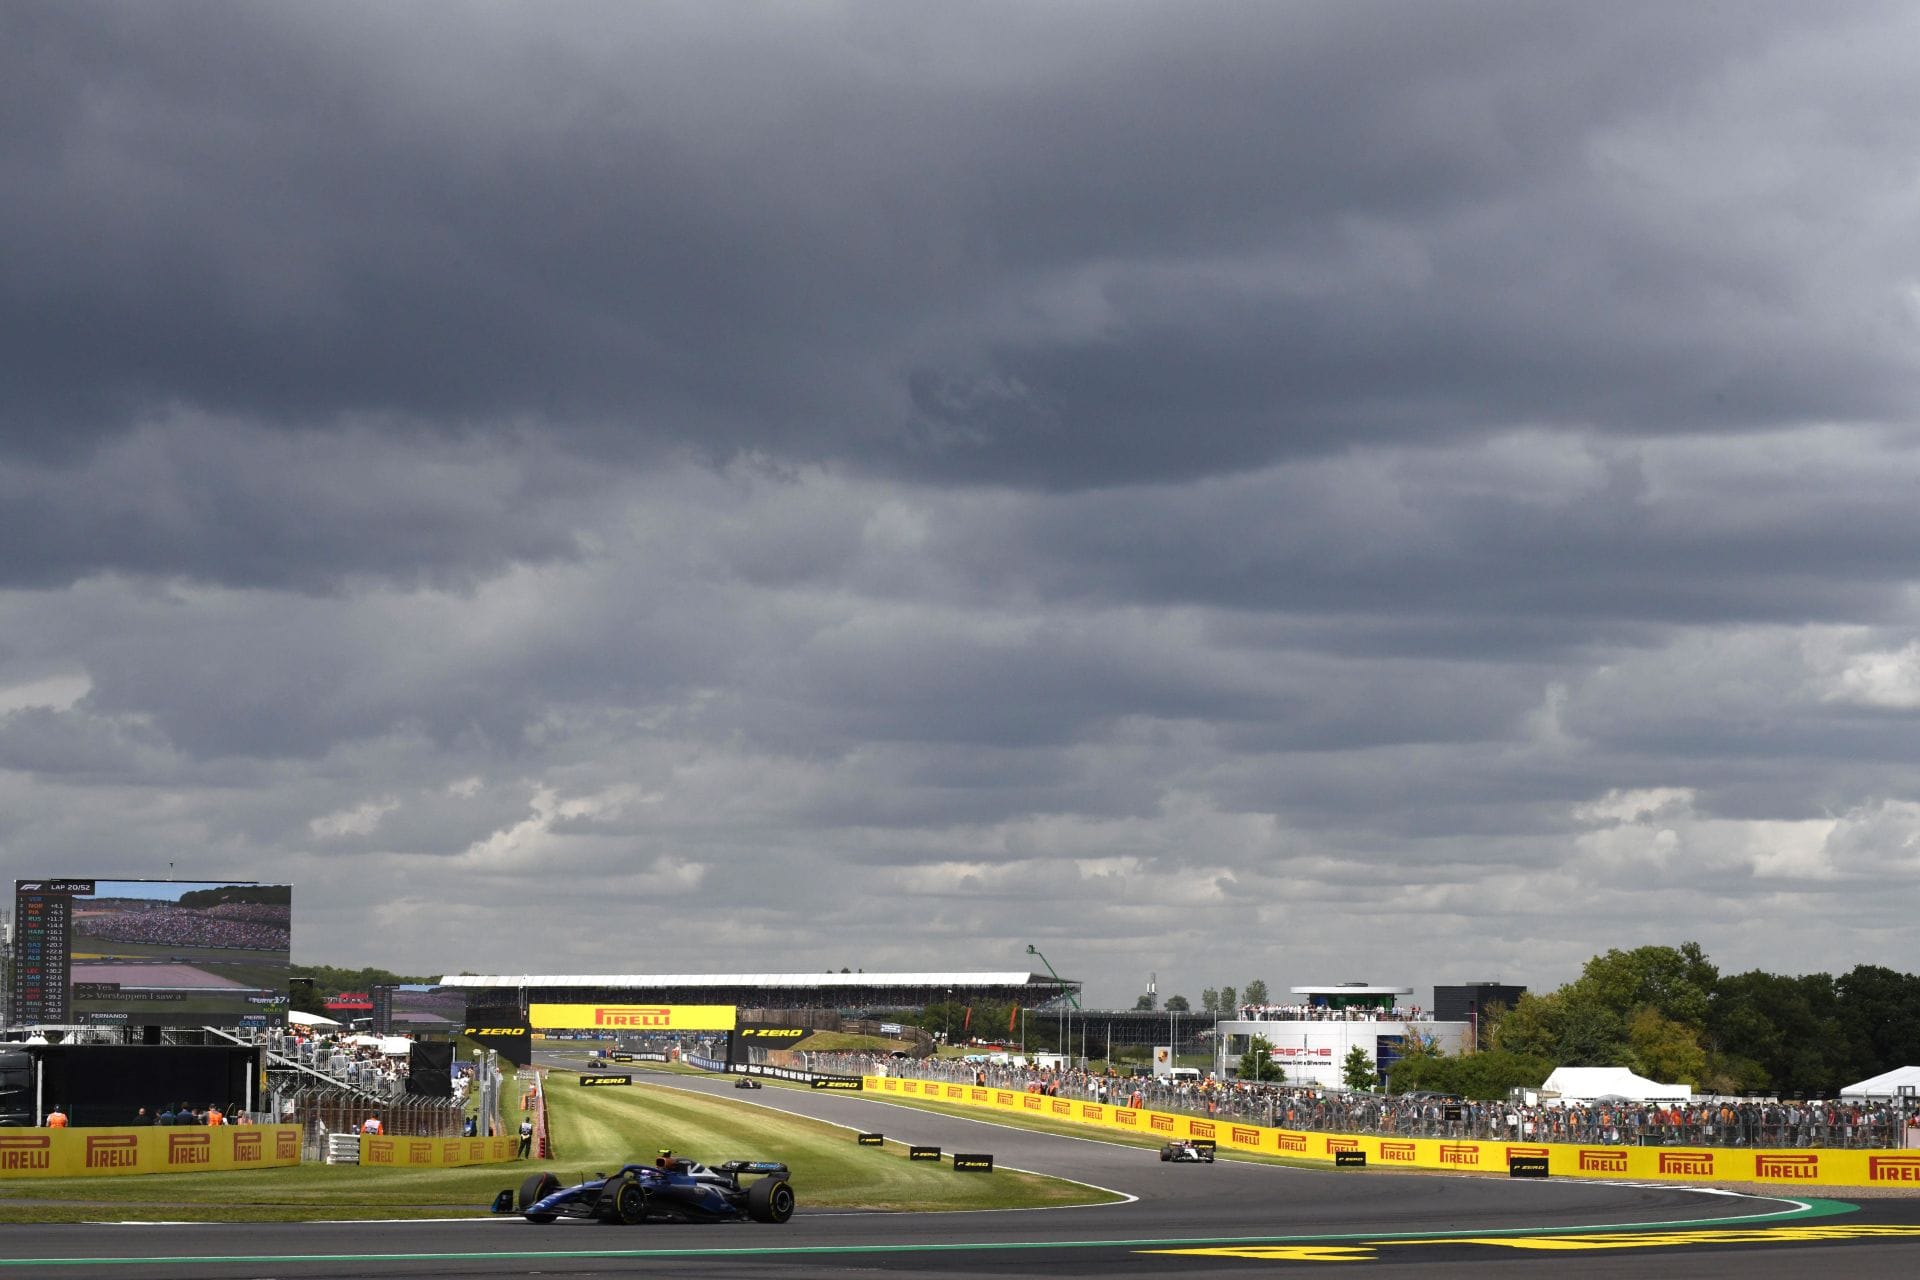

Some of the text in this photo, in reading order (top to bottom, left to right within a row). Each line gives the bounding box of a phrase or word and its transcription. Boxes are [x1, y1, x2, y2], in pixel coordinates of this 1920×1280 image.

[595, 1008, 670, 1025] PIRELLI
[1024, 1096, 1041, 1110] PIRELLI
[1052, 1100, 1070, 1115] PIRELLI
[1083, 1105, 1102, 1120] PIRELLI
[1116, 1110, 1136, 1125] PIRELLI
[1151, 1114, 1174, 1131] PIRELLI
[1190, 1120, 1215, 1138] PIRELLI
[276, 1131, 296, 1159] PIRELLI
[1232, 1127, 1259, 1145] PIRELLI
[1278, 1134, 1306, 1152] PIRELLI
[86, 1135, 137, 1168] PIRELLI
[168, 1134, 210, 1164] PIRELLI
[234, 1132, 261, 1161] PIRELLI
[369, 1141, 394, 1162] PIRELLI
[410, 1142, 432, 1163] PIRELLI
[1381, 1143, 1415, 1160] PIRELLI
[1440, 1145, 1479, 1164] PIRELLI
[1580, 1150, 1627, 1171] PIRELLI
[1659, 1153, 1714, 1175] PIRELLI
[1756, 1155, 1818, 1178] PIRELLI
